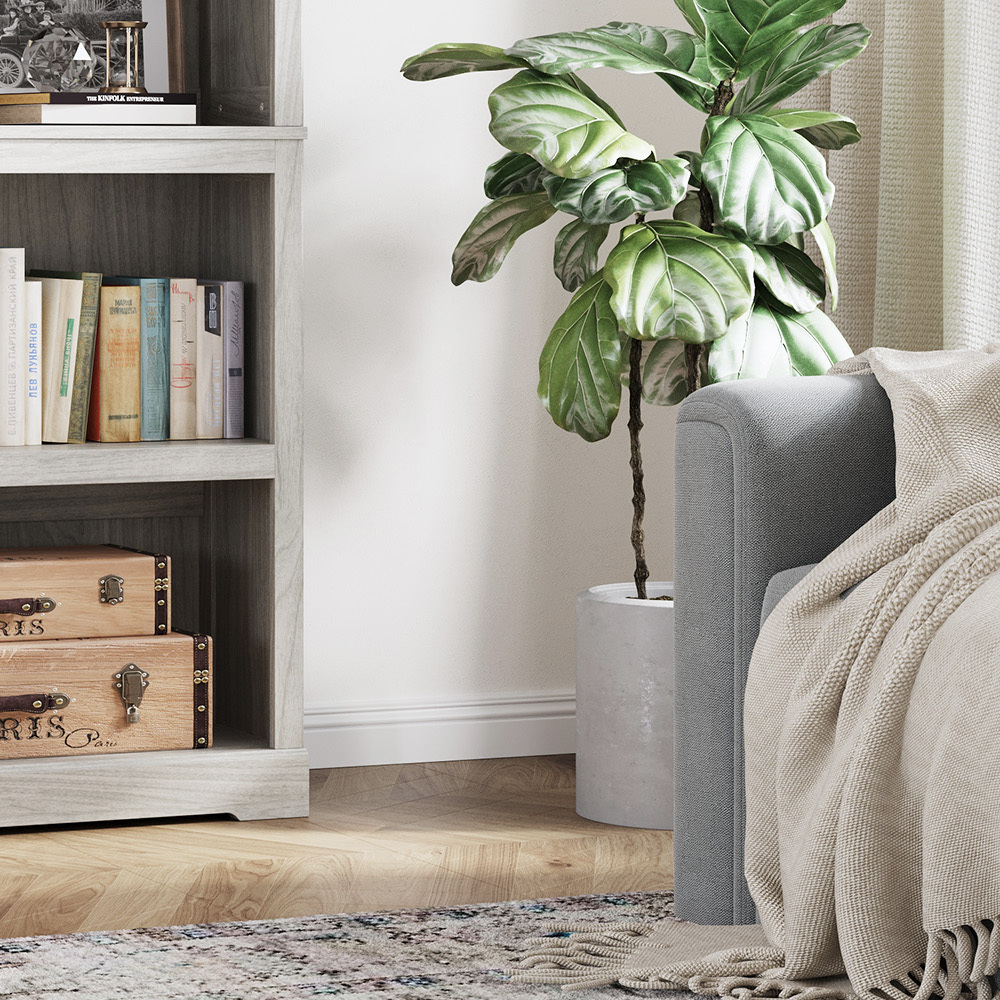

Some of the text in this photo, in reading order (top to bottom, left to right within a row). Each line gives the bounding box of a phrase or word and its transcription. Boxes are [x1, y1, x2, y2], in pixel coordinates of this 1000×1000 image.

[8, 256, 17, 279] КРАЙ
[29, 323, 38, 398] ЛЕВ ЛУКЬЯНОВ
